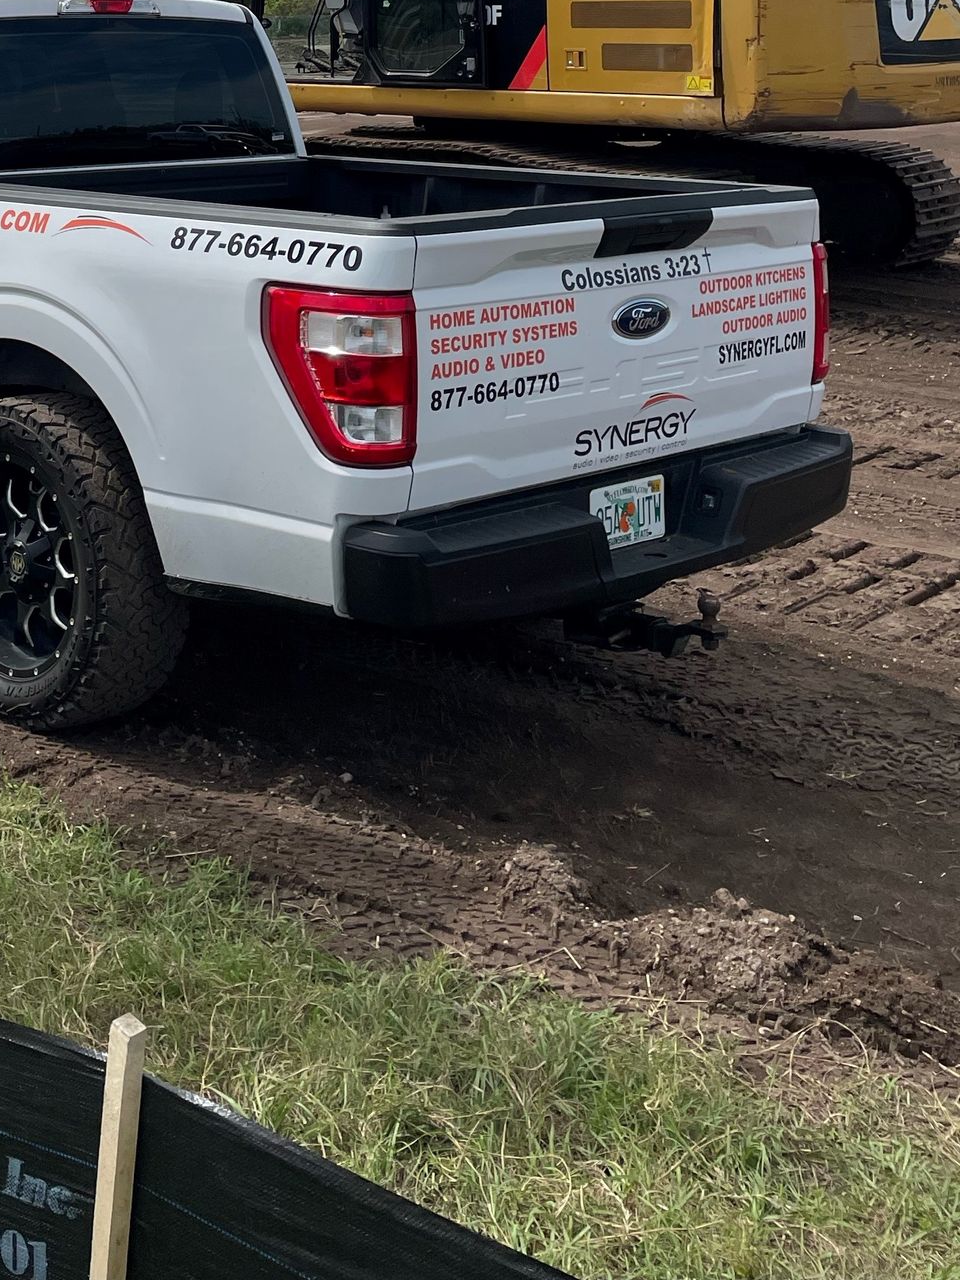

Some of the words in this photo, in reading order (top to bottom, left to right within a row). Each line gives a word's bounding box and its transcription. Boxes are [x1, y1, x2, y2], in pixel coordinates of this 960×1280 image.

[170, 227, 363, 272] 877-664-0770
[561, 263, 661, 292] Colossians
[664, 254, 701, 279] 3:23
[700, 274, 753, 295] OUTDOOR
[756, 266, 806, 287] KITCHENS
[430, 310, 475, 330] HOME
[480, 297, 575, 324] AUTOMATION
[629, 307, 659, 331] Ford
[692, 295, 756, 318] LANDSCAPE
[759, 287, 806, 307] LIGHTING
[722, 313, 773, 334] OUTDOOR
[776, 307, 807, 325] AUDIO
[431, 330, 507, 355] SECURITY
[512, 321, 578, 344] SYSTEMS
[719, 330, 806, 364] SYNERGYFL.COM
[431, 358, 480, 380] AUDIO
[485, 356, 495, 372] &
[501, 349, 545, 370] VIDEO
[430, 372, 560, 412] 877-664-0770
[574, 408, 696, 457] SYNERGY
[572, 459, 593, 470] audio
[600, 454, 619, 465] video
[625, 445, 657, 460] security
[661, 437, 688, 452] control
[637, 492, 661, 528] UTW
[2, 1155, 83, 1220] Inc.
